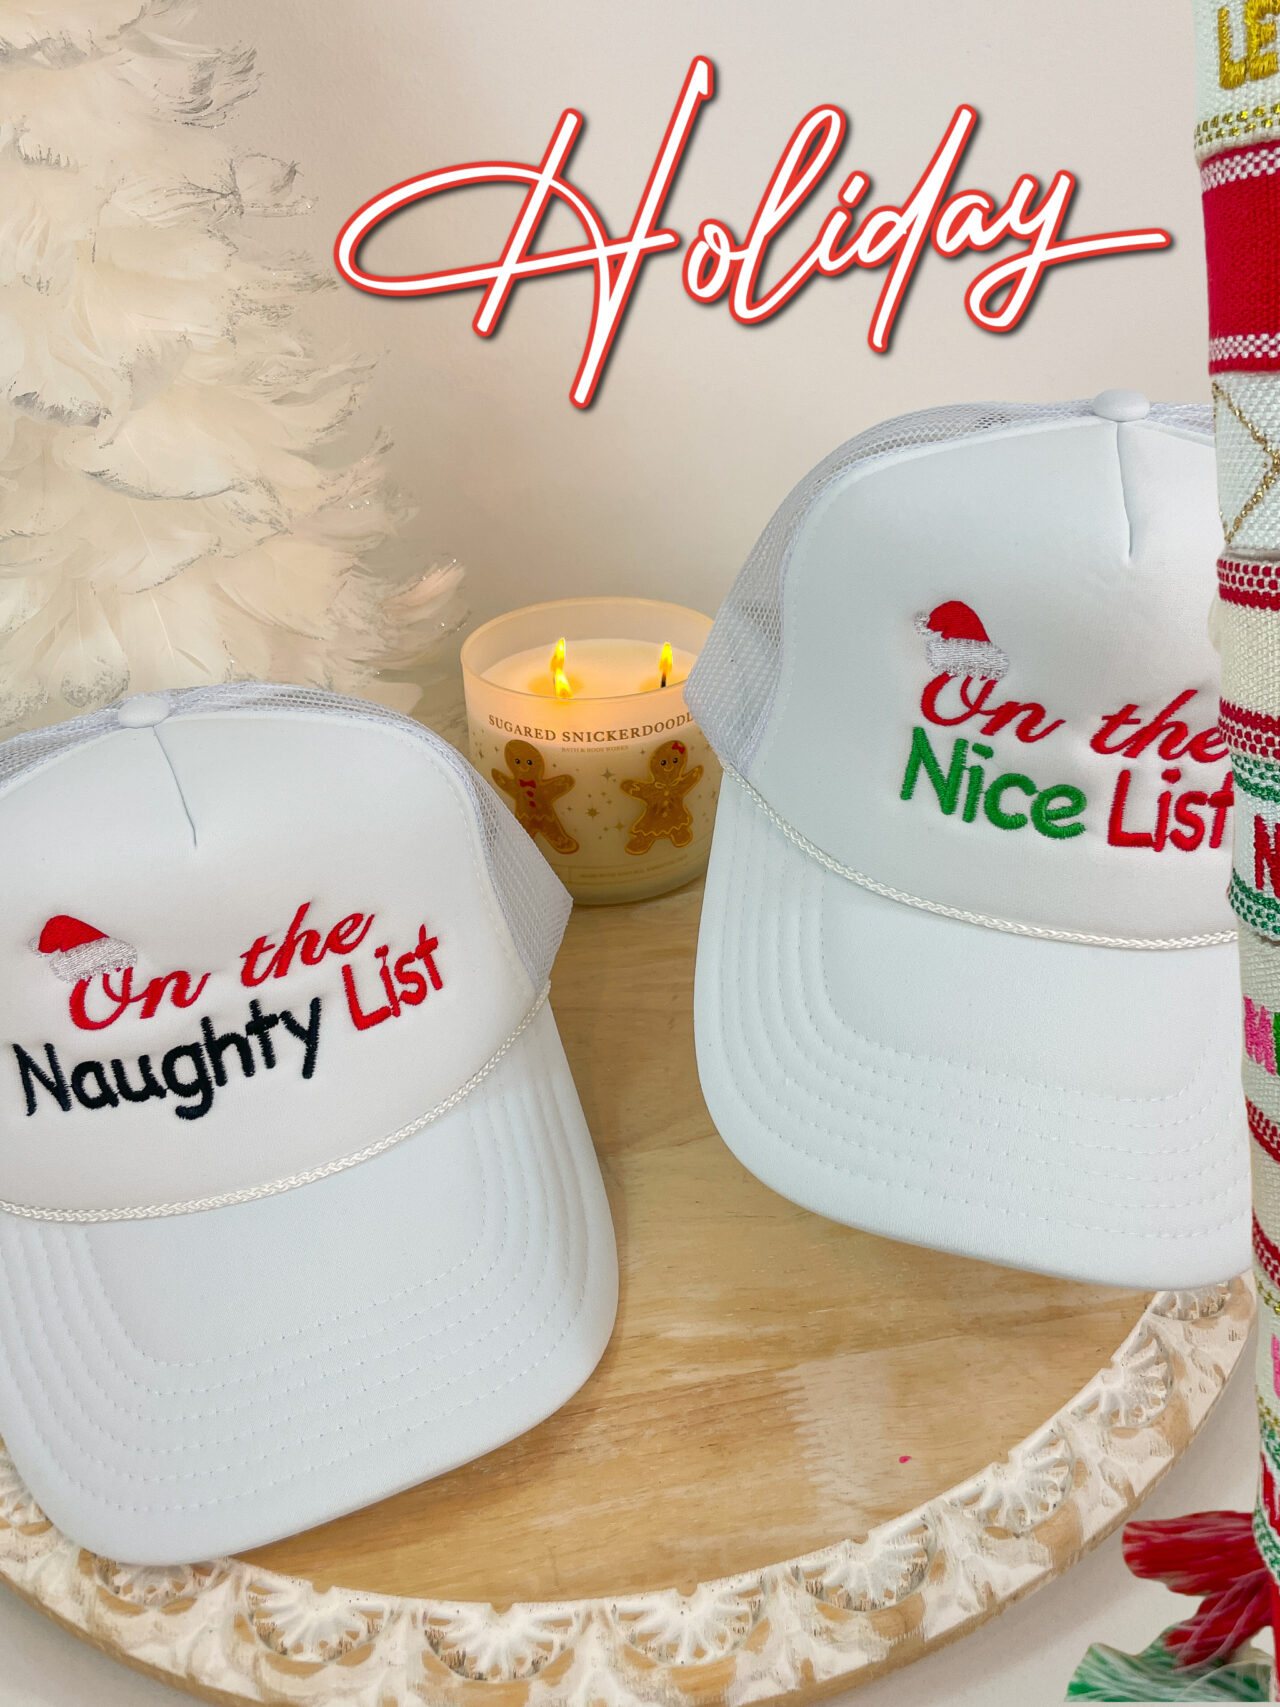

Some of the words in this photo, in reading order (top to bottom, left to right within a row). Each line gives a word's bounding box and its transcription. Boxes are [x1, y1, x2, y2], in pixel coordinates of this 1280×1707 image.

[489, 714, 556, 741] SUGARED
[921, 671, 1066, 743] On
[1090, 689, 1229, 763] the
[900, 726, 1087, 839] Nice
[1107, 769, 1235, 853] List
[13, 997, 322, 1120] Naughty
[341, 923, 443, 1030] List
[70, 966, 212, 1030] On
[240, 902, 375, 988] the
